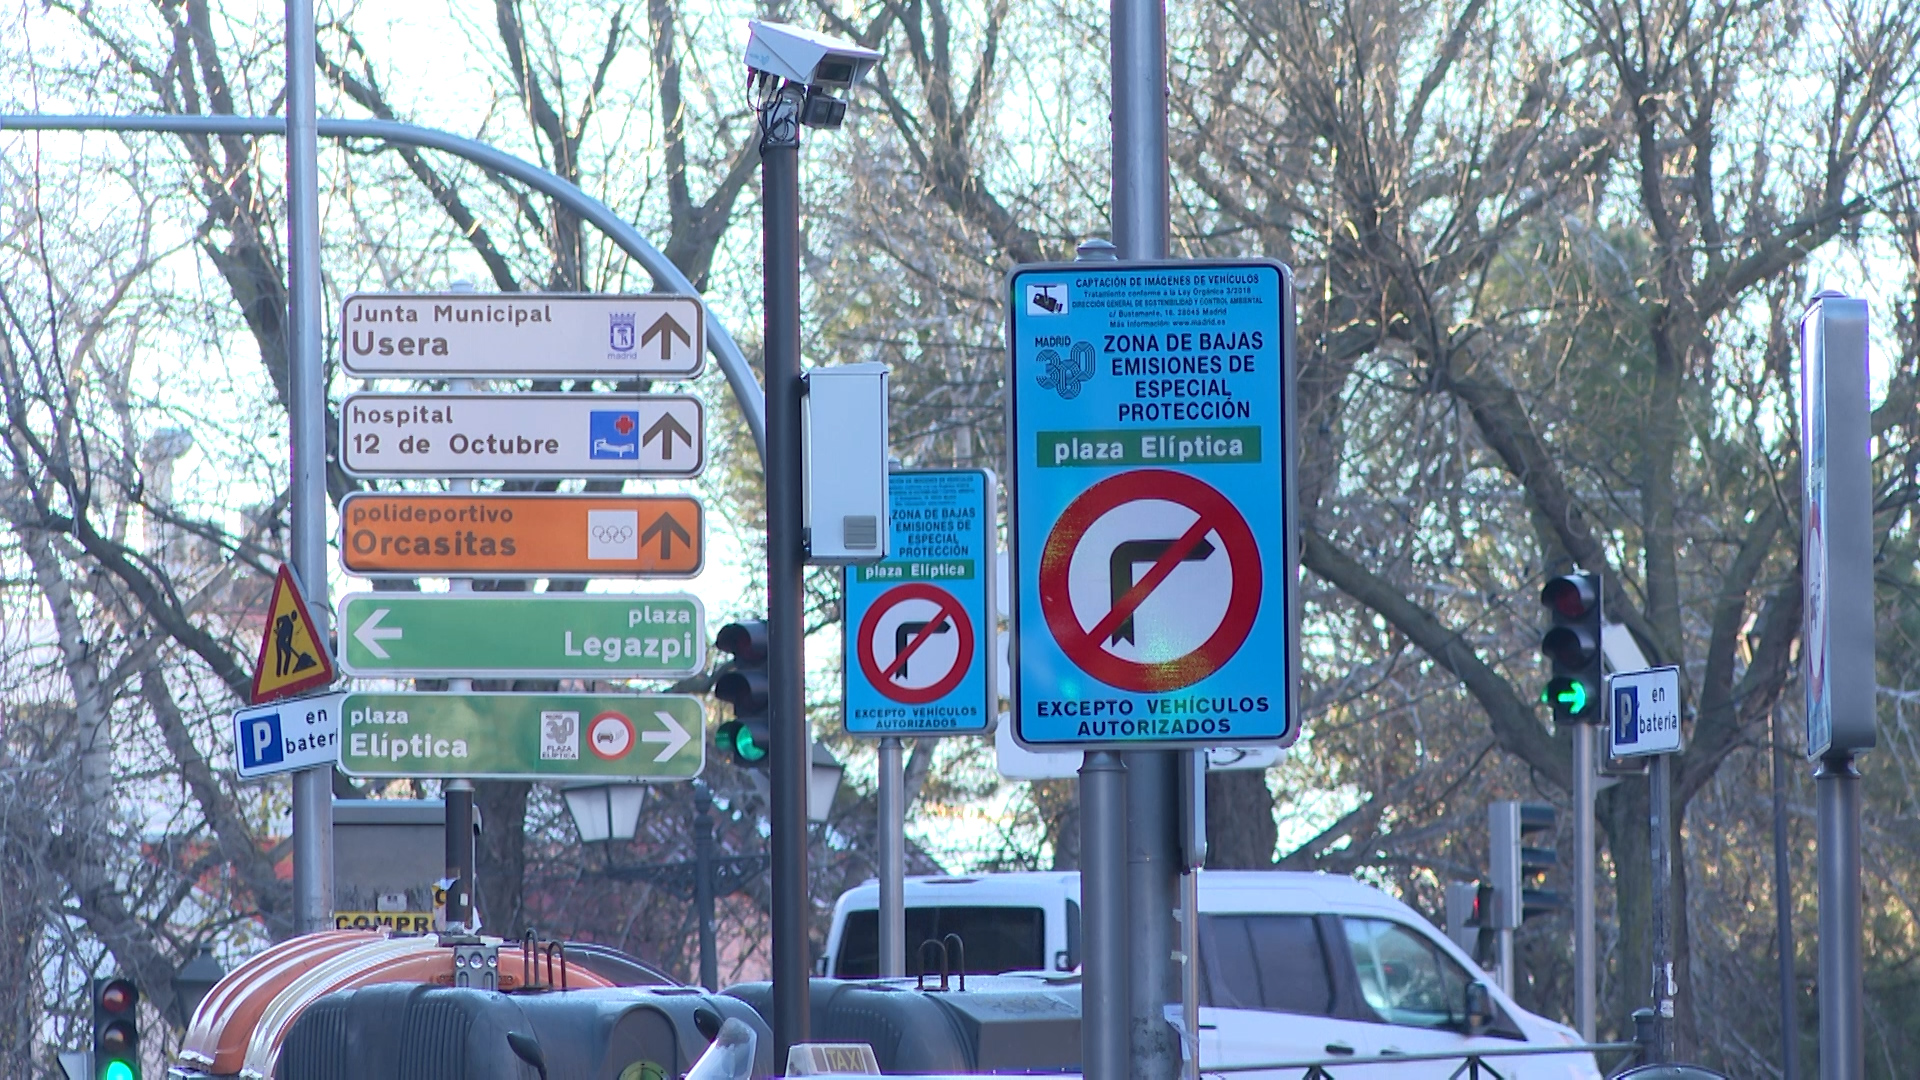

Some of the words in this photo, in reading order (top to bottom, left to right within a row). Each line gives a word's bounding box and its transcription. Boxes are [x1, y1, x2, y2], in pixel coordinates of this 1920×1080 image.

[1076, 276, 1126, 288] CAPTACIÓN
[1130, 277, 1141, 286] DE
[1144, 274, 1190, 286] IMÁGENES
[1193, 275, 1206, 285] DE
[1208, 273, 1259, 284] VEHÍCULOS
[1178, 289, 1191, 297] Ley
[353, 304, 418, 323] Junta
[434, 304, 552, 327] Municipal
[353, 331, 449, 356] Usera
[1035, 336, 1071, 347] MADRID
[1103, 335, 1159, 352] ZONA
[1167, 333, 1192, 351] DE
[1200, 331, 1263, 350] BAJAS
[1112, 356, 1222, 376] EMISIONES
[1229, 355, 1255, 373] DE
[1136, 379, 1232, 398] ESPECIAL
[353, 405, 453, 427] hospital
[1119, 397, 1250, 422] PROTECCIÓN
[354, 435, 380, 454] 12
[399, 434, 430, 454] de
[449, 434, 559, 455] Octubre
[1055, 438, 1123, 464] plaza
[1141, 435, 1243, 461] Elíptica
[353, 505, 513, 527] polideportivo
[892, 508, 920, 519] ZONA
[924, 509, 938, 519] DE
[942, 507, 975, 518] BAJAS
[896, 520, 954, 532] EMISIONES
[957, 520, 971, 530] DE
[353, 529, 516, 557] Orcasitas
[908, 534, 959, 544] ESPECIAL
[899, 544, 969, 557] PROTECCIÓN
[866, 565, 902, 579] plaza
[911, 563, 965, 578] Elíptica
[629, 606, 690, 627] plaza
[564, 631, 692, 663] Legazpi
[1652, 687, 1665, 703] en
[855, 708, 906, 719] EXCEPTO
[912, 706, 977, 716] VEHÍCULOS
[1037, 699, 1133, 716] EXCEPTO
[1147, 696, 1269, 714] VEHÍCULOS
[1621, 693, 1632, 738] P
[306, 709, 327, 724] en
[350, 708, 409, 726] plaza
[876, 719, 957, 729] AUTORIZADOS
[1639, 710, 1677, 733] batería
[1078, 718, 1231, 736] AUTORIZADOS
[253, 721, 272, 762] P
[286, 728, 338, 754] bater
[350, 732, 468, 762] Elíptica
[336, 915, 437, 931] COMPR
[827, 1050, 864, 1070] TAXI
